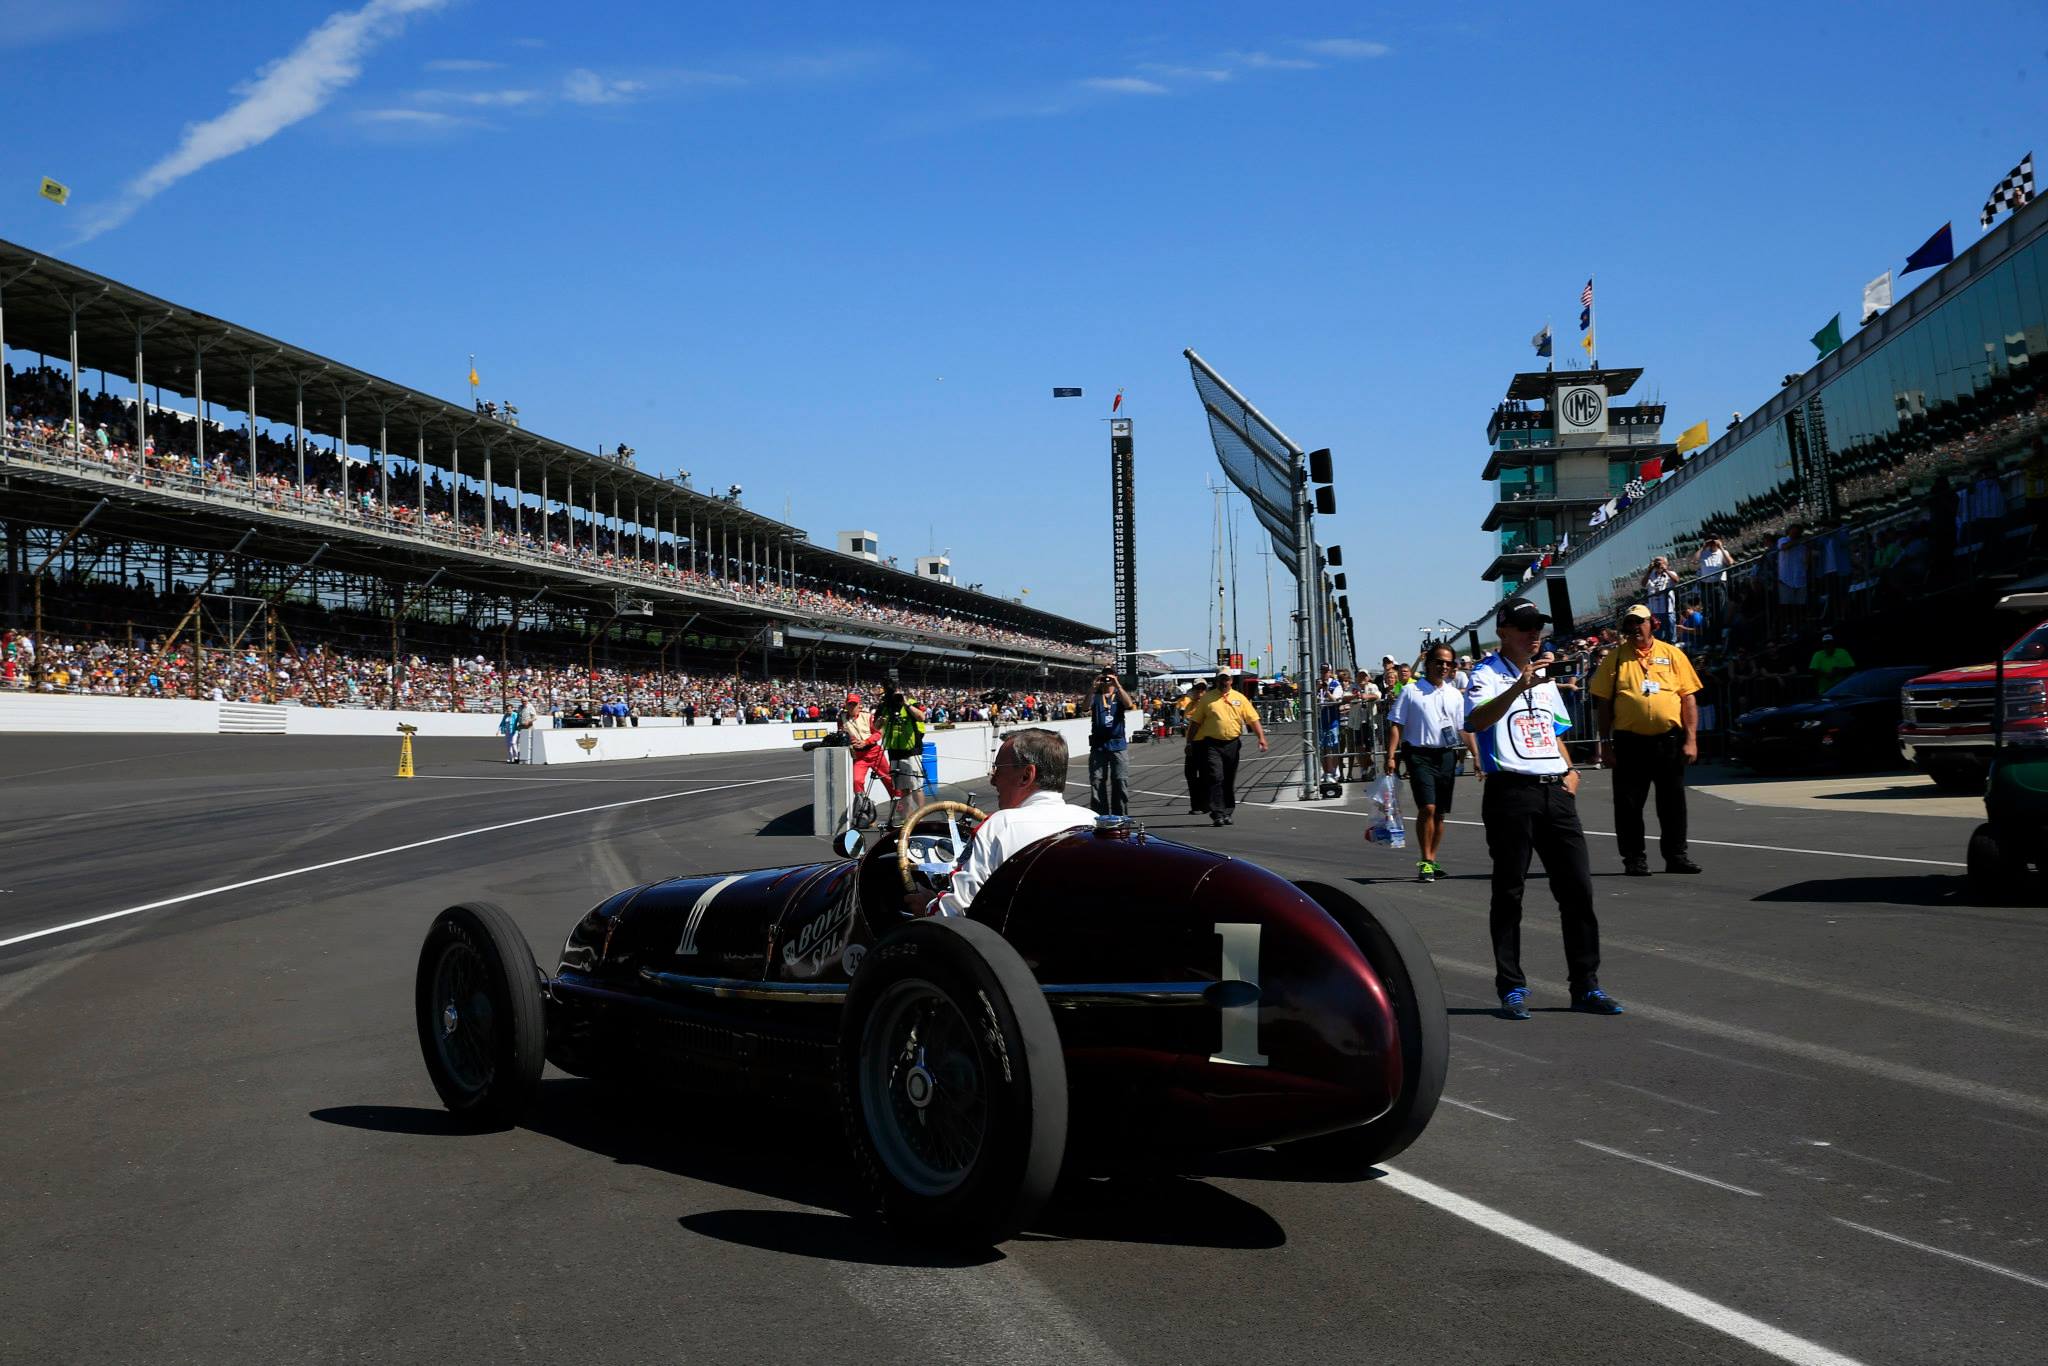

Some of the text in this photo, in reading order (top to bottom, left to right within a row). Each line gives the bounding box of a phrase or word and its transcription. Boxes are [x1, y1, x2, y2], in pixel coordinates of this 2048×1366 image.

[1569, 393, 1597, 421] IMS
[1620, 416, 1626, 424] 5
[1631, 416, 1637, 424] 6
[1654, 415, 1660, 423] 8
[1500, 420, 1539, 430] 1 2 3 4
[675, 875, 749, 954] 1
[1208, 922, 1269, 1066] 1
